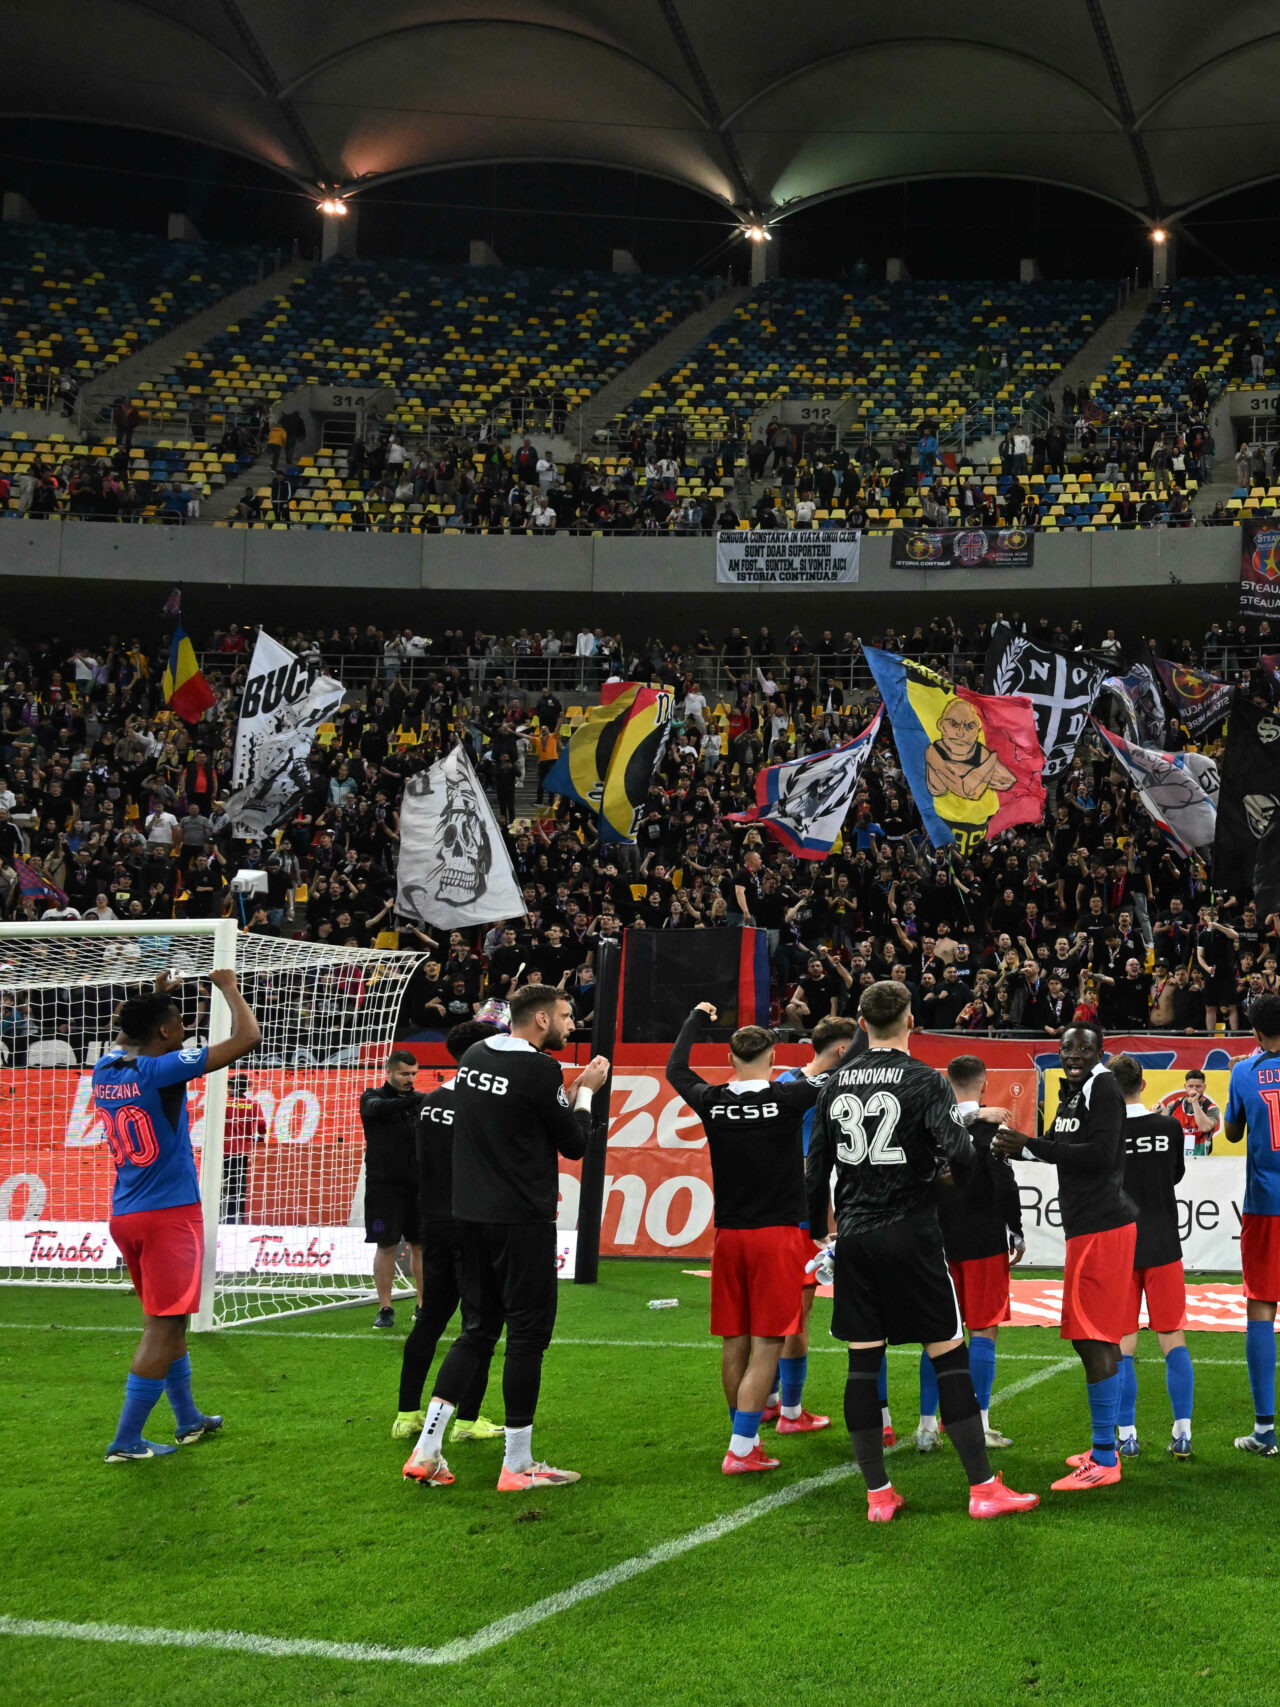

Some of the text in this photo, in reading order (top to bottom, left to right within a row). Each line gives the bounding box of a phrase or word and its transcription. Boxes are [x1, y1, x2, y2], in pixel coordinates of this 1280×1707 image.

[333, 396, 364, 407] 314
[802, 408, 831, 420] 312
[720, 532, 748, 544] SINGURA
[750, 532, 789, 544] CONSTANTA
[790, 532, 798, 544] IN
[800, 532, 820, 544] VIATA
[822, 532, 838, 544] UNUI
[744, 545, 831, 557] SUNT DOAR SUPORTERII
[728, 558, 740, 571] AM
[800, 558, 806, 571] SI
[808, 558, 823, 571] VOM
[825, 558, 831, 571] FI
[832, 558, 846, 571] AICI
[737, 572, 776, 581] ISTORIA
[456, 1066, 509, 1096] FCSB
[838, 1067, 904, 1087] TARNOVANU
[92, 1082, 141, 1100] NGEZANA
[420, 1106, 455, 1125] FCS
[710, 1102, 779, 1119] FCSB
[830, 1090, 908, 1166] 32
[24, 1229, 104, 1262] Turabo
[250, 1234, 332, 1268] Turabo
